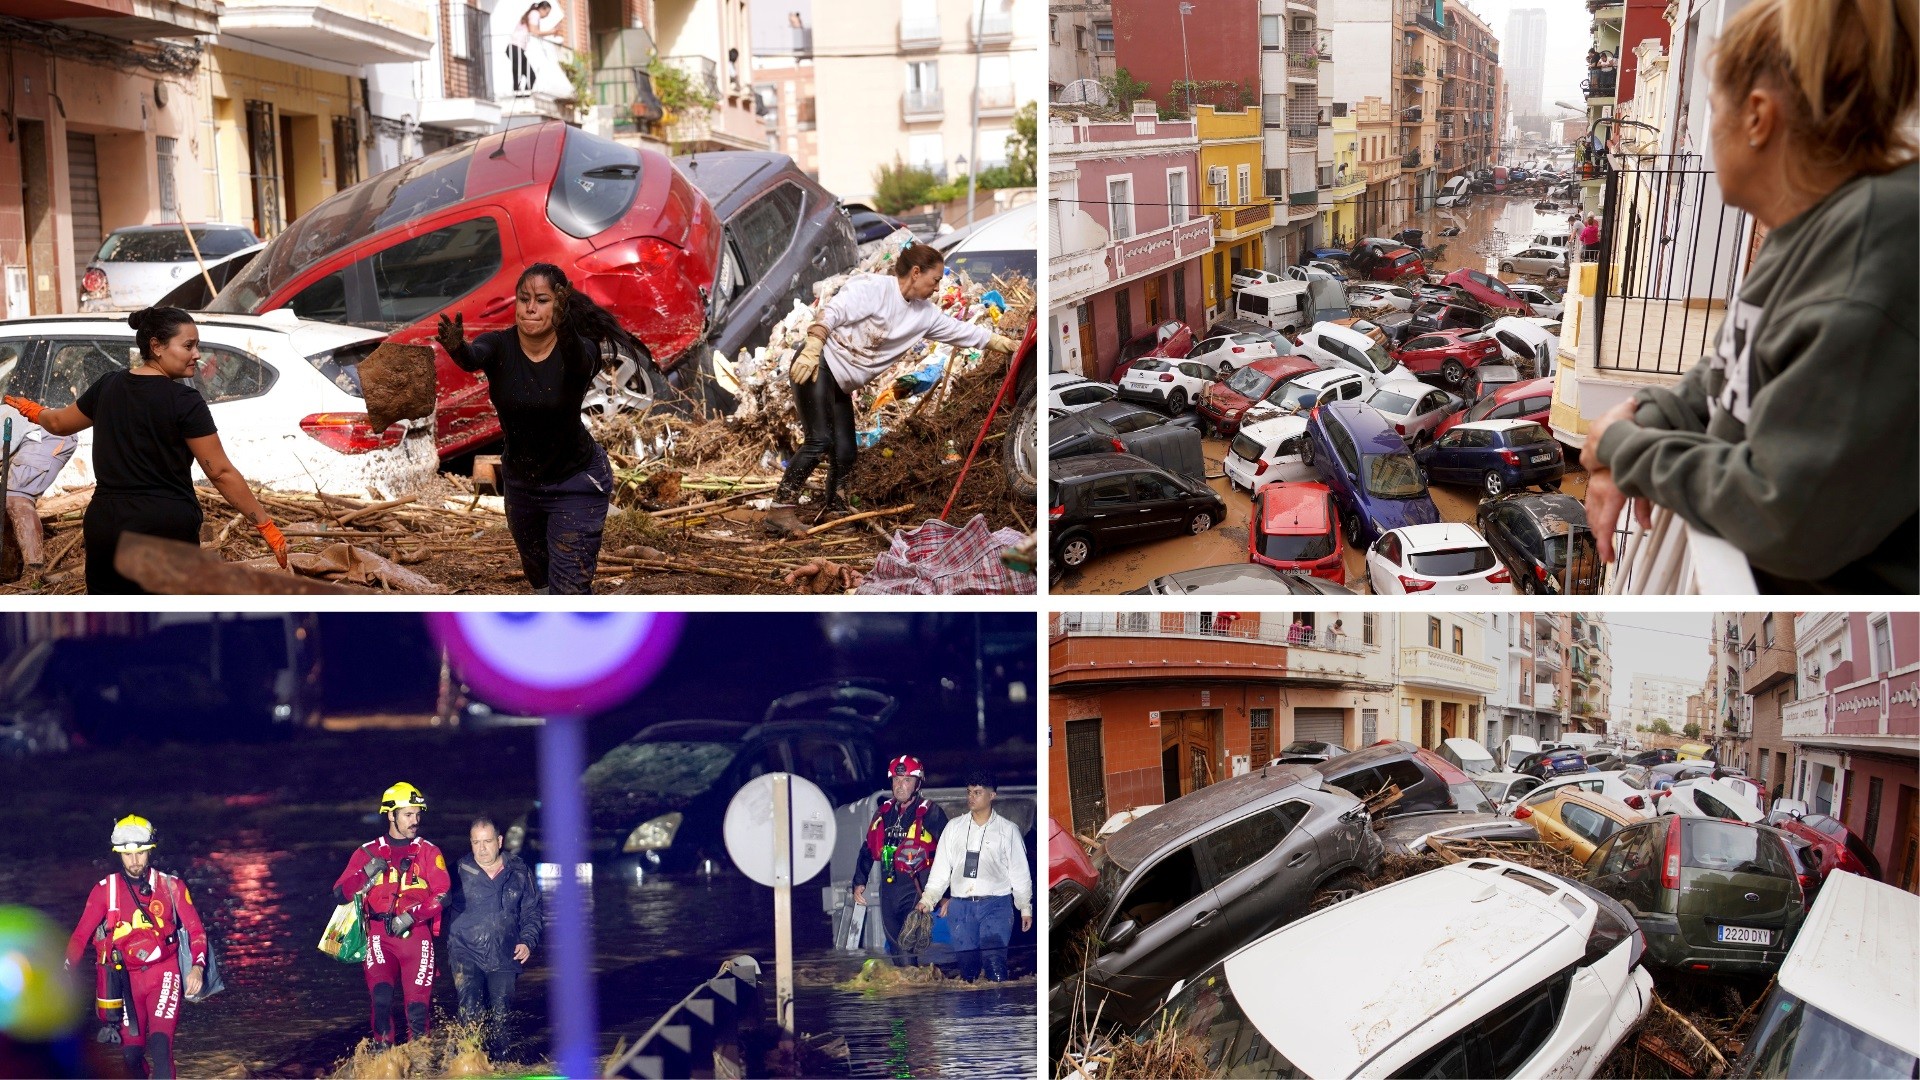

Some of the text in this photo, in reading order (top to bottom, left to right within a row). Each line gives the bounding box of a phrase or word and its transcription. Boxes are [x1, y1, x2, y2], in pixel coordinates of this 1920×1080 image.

[1725, 927, 1768, 943] 2220 DXY
[415, 940, 430, 986] BOMBERS
[154, 971, 173, 1017] BOMBERS
[164, 974, 180, 1019] VALÈNCIA
